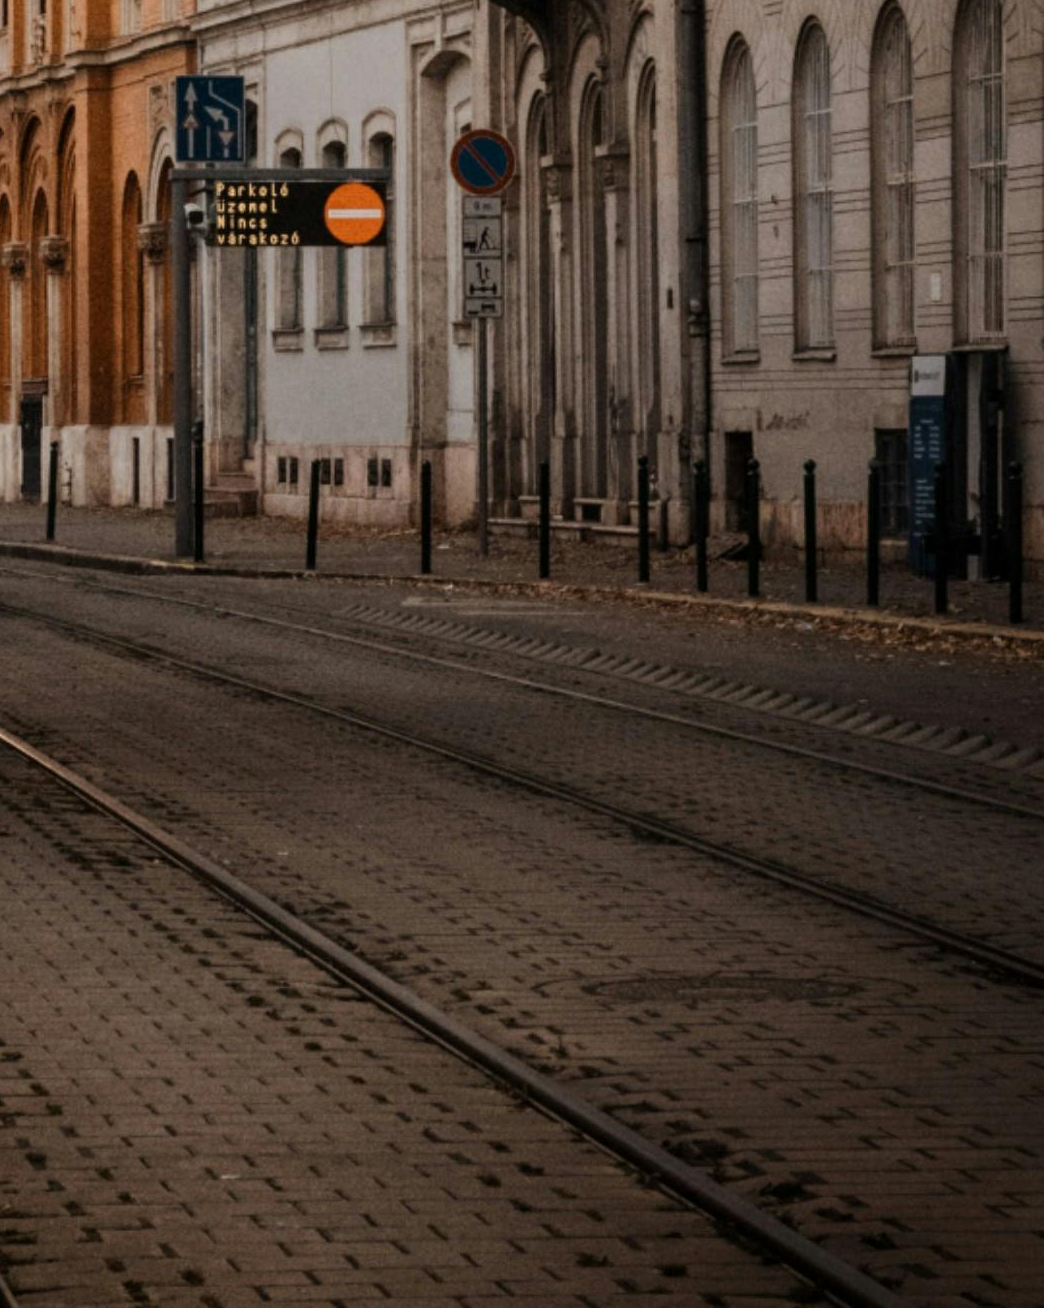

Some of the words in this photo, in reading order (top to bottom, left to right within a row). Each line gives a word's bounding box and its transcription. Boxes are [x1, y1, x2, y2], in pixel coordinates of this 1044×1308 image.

[216, 180, 289, 197] Parkoló
[217, 198, 278, 213] üzemel
[217, 214, 268, 230] Nincs
[217, 230, 301, 246] várakozó
